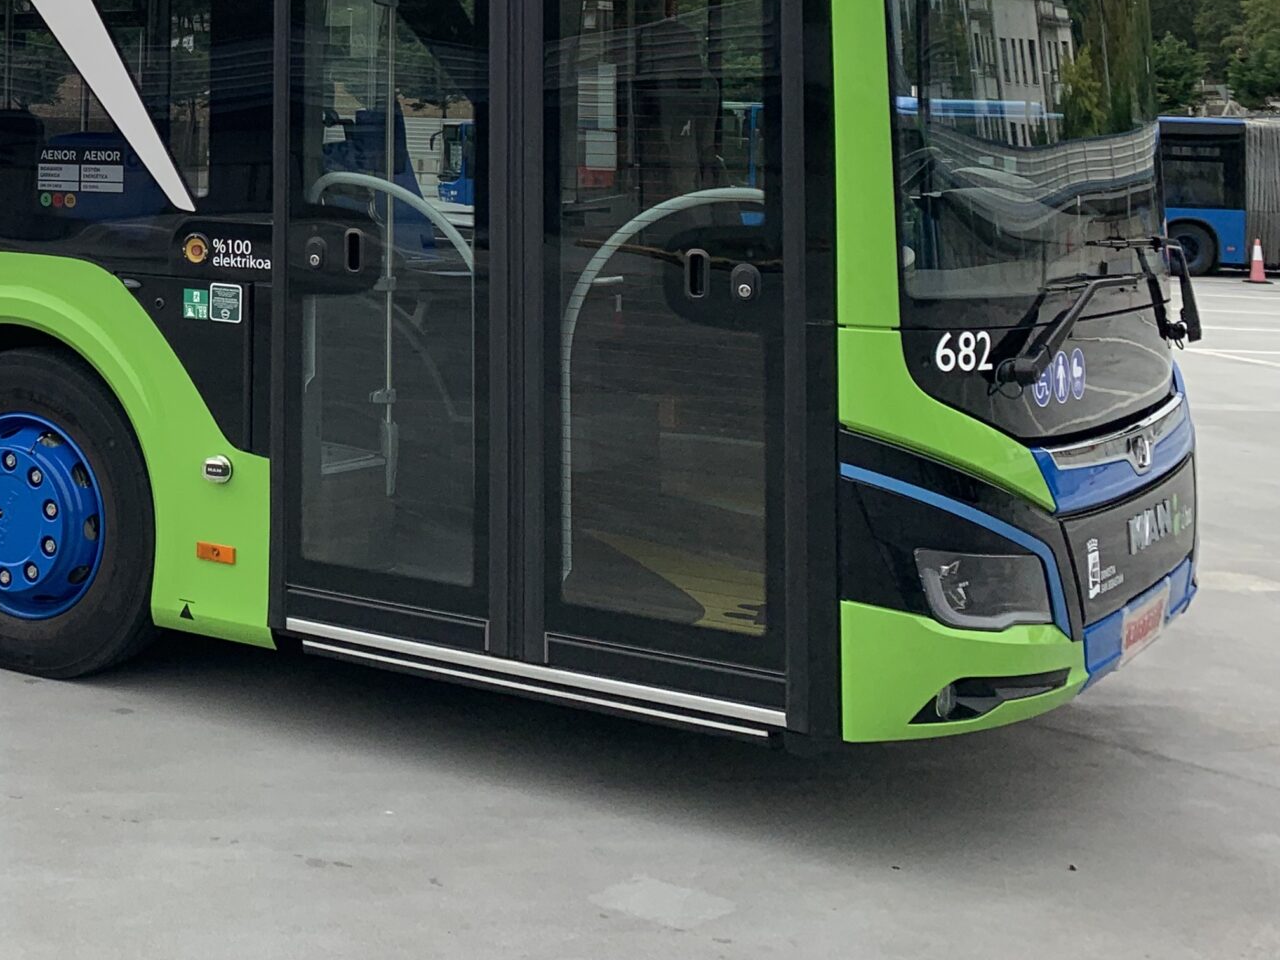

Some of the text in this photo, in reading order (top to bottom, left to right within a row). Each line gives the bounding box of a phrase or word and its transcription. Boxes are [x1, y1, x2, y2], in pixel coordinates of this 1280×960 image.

[40, 150, 76, 160] AENOR
[83, 150, 120, 161] AENOR
[212, 239, 251, 254] %100
[212, 253, 271, 269] elektrikoa
[936, 331, 993, 372] 682
[1127, 498, 1170, 555] MAN
